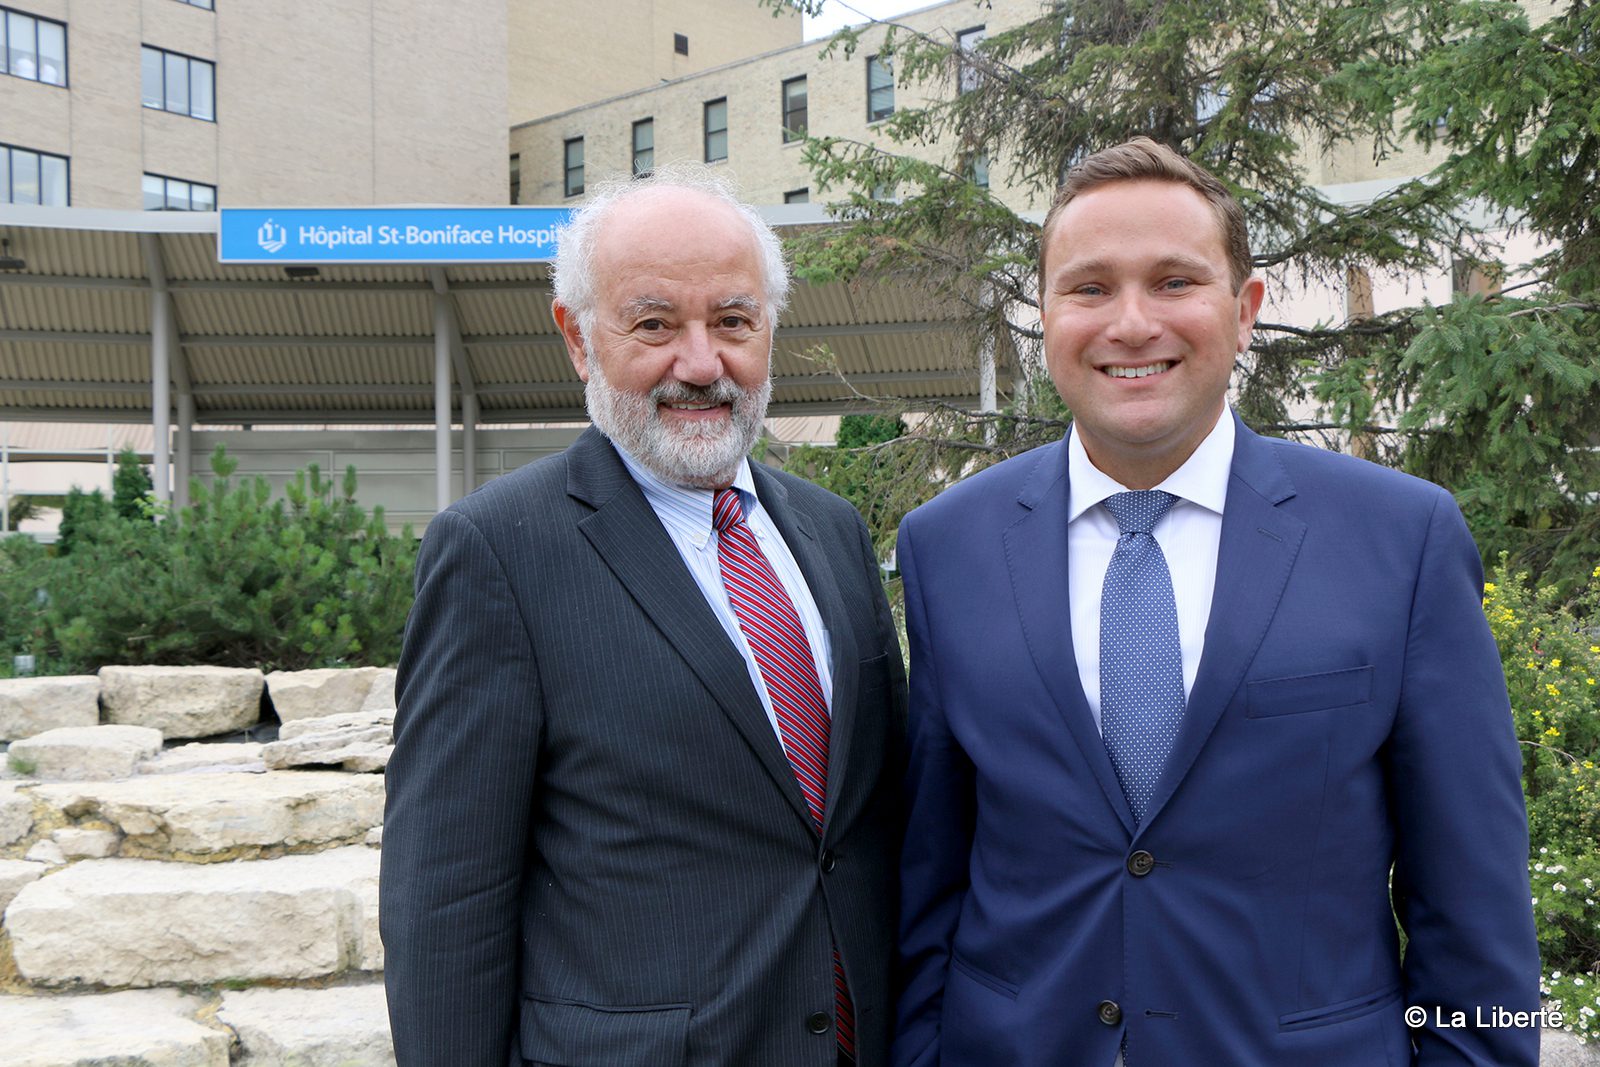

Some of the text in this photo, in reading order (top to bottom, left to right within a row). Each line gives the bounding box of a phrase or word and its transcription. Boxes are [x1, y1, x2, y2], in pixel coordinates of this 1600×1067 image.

[299, 224, 555, 249] Hôpital St-Boniface Hospi
